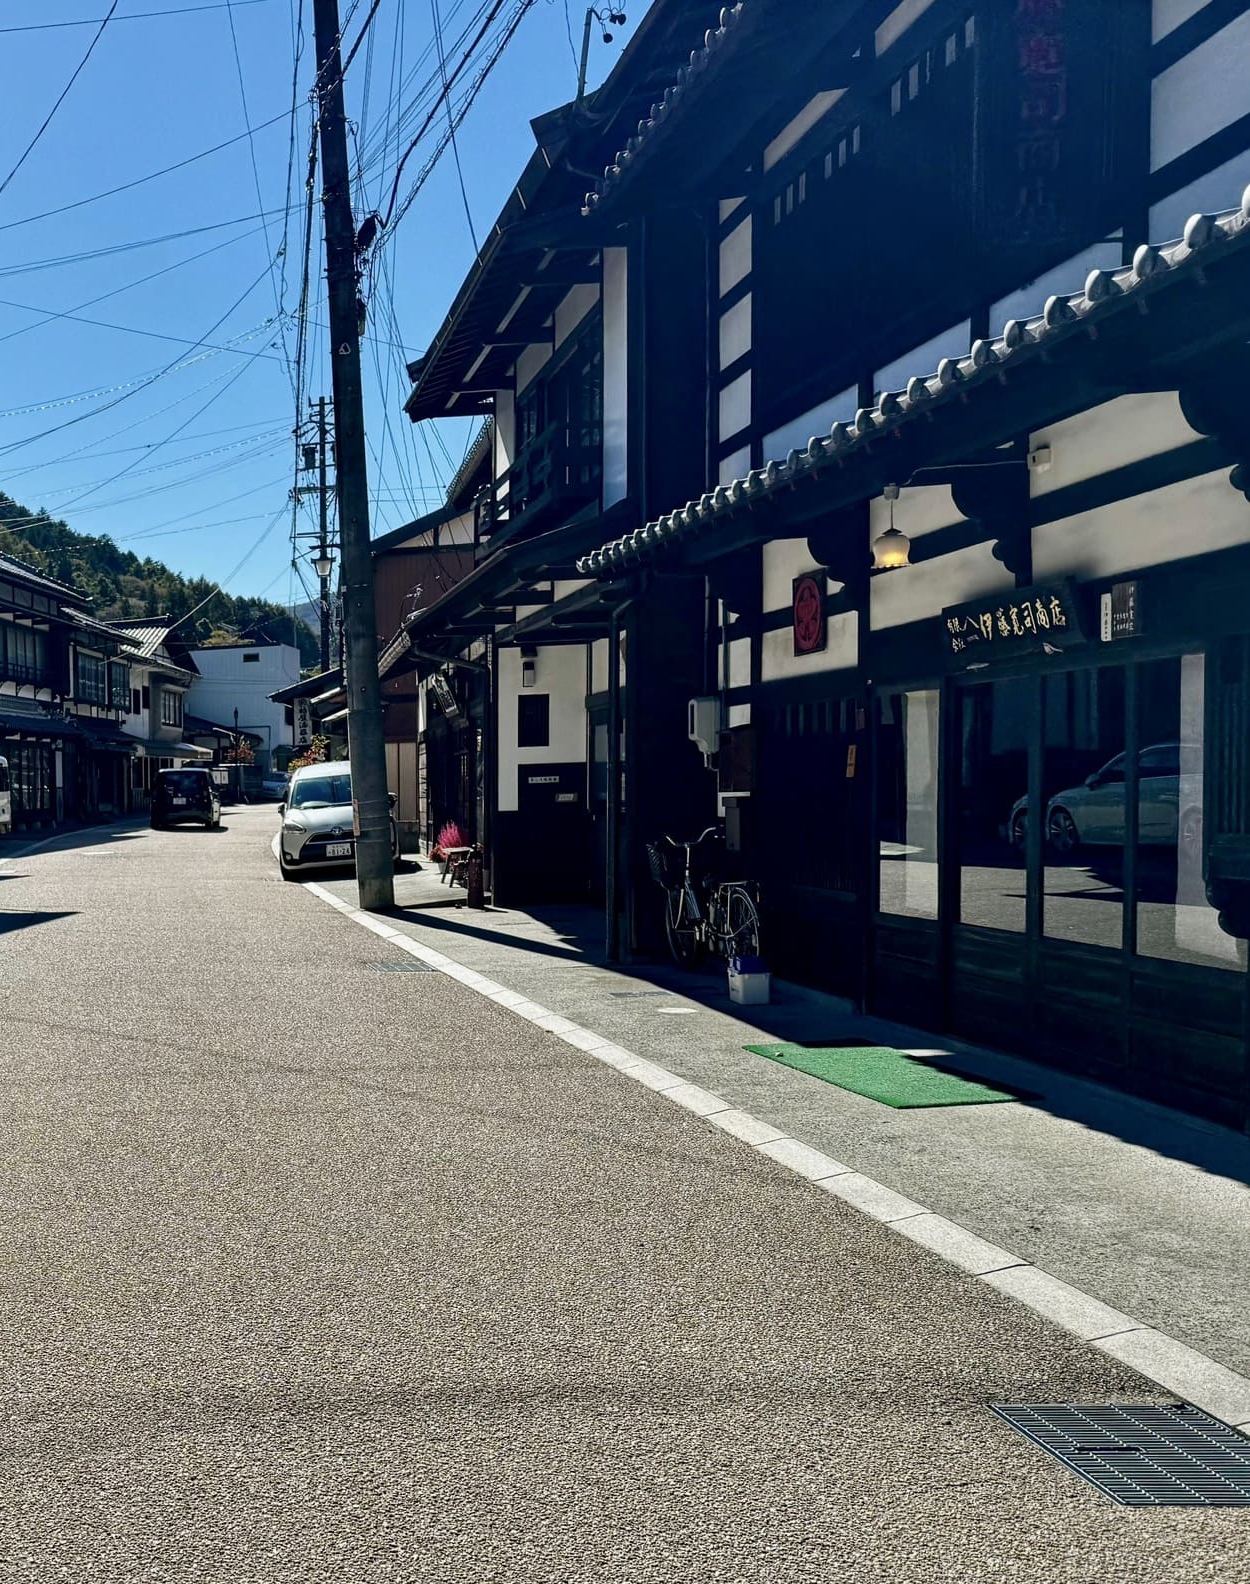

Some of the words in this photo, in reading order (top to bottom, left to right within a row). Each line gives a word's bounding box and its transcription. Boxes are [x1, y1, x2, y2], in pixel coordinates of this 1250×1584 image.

[979, 596, 1067, 640] 伊藤寛司商店
